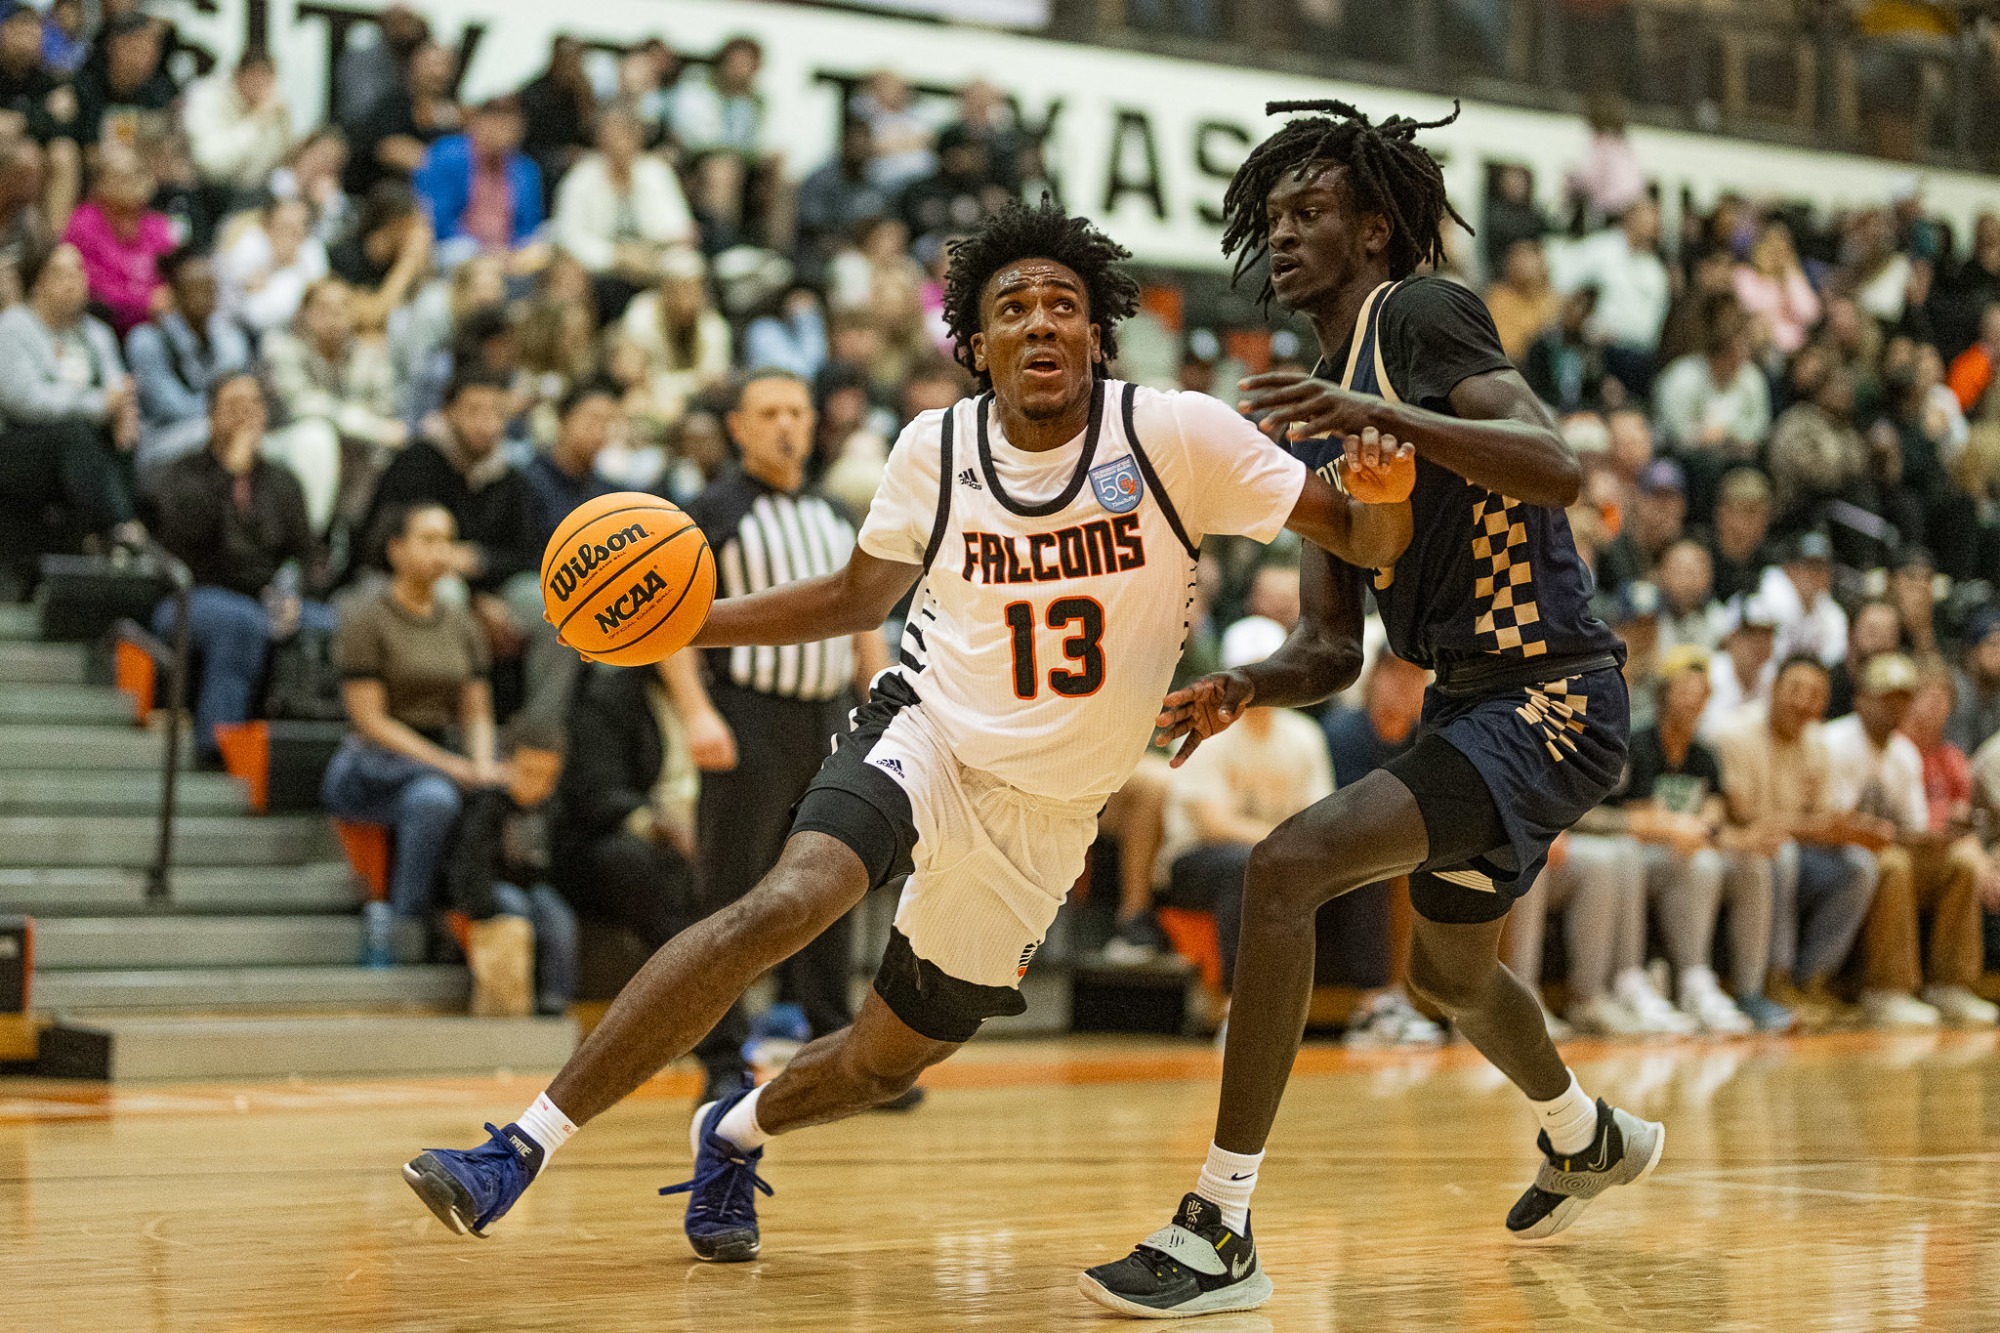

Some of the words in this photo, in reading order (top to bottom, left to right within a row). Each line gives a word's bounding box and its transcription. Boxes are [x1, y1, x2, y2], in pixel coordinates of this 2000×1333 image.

[813, 70, 1252, 228] TXAS
[550, 523, 650, 602] Wilson
[962, 512, 1145, 584] FALCONS
[594, 570, 668, 634] NCAA
[1004, 595, 1106, 700] 13
